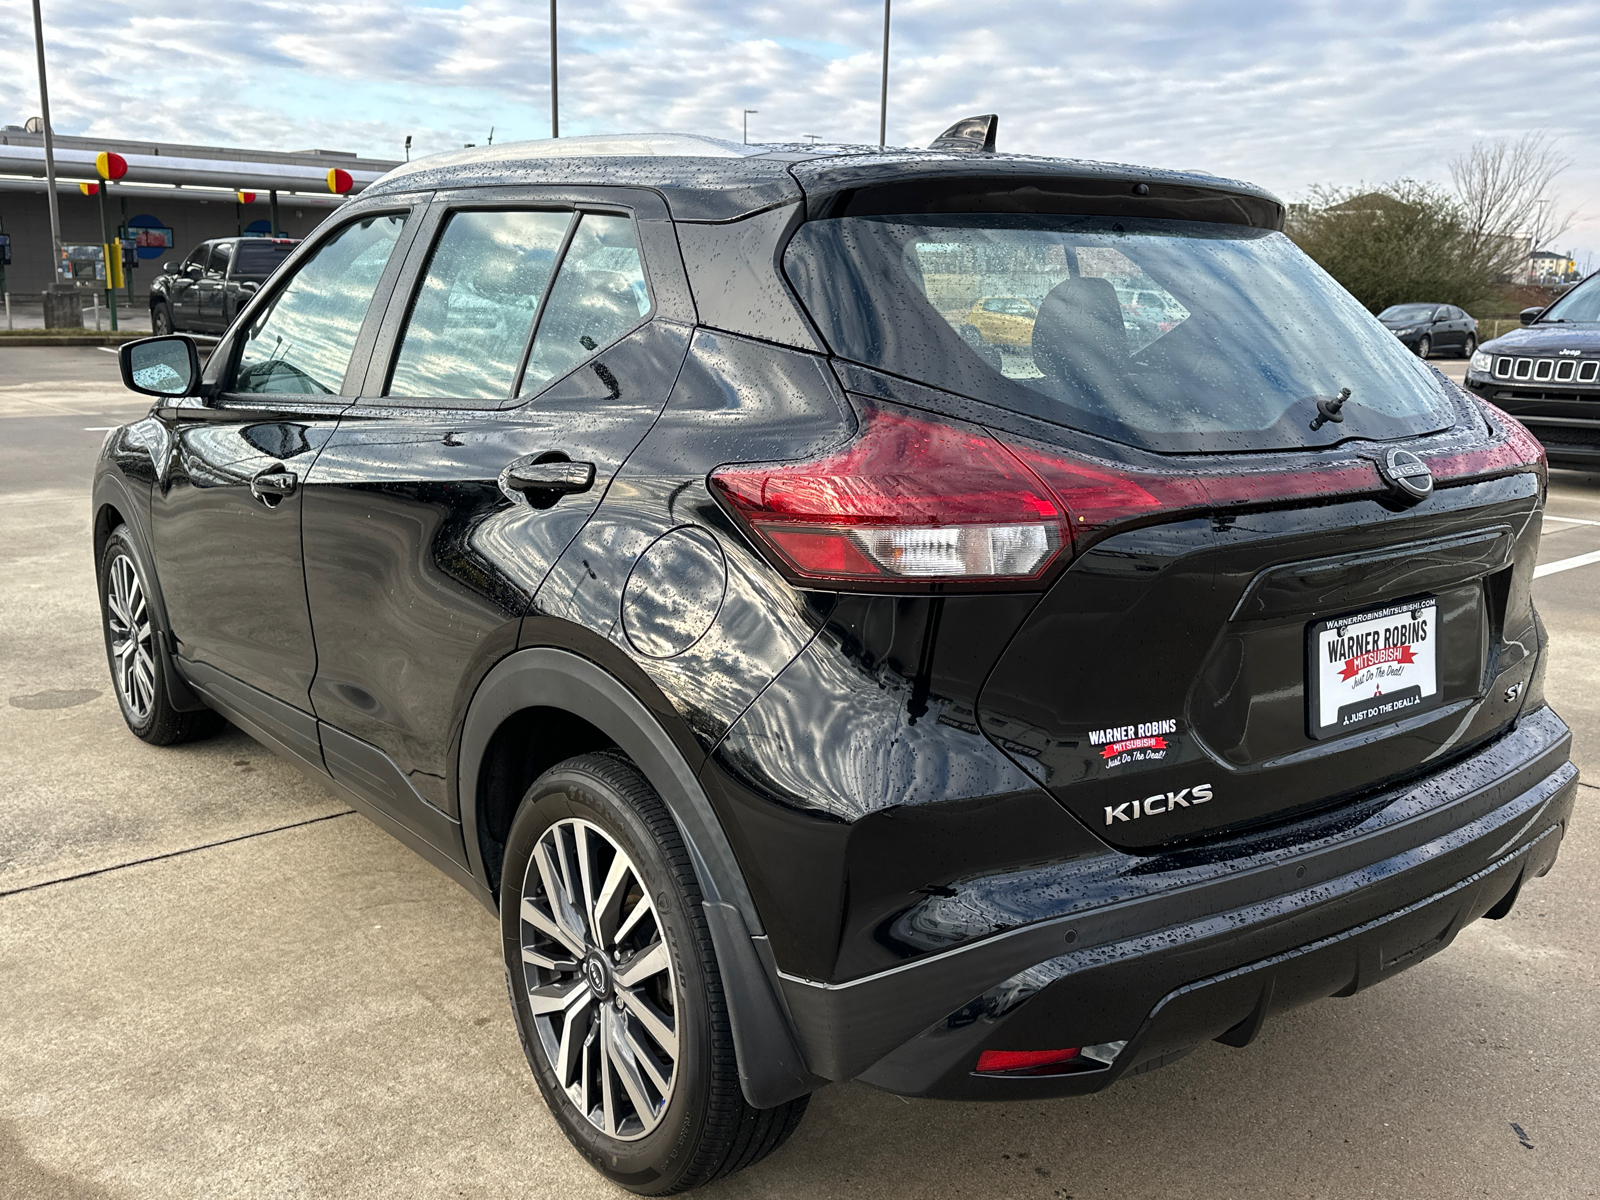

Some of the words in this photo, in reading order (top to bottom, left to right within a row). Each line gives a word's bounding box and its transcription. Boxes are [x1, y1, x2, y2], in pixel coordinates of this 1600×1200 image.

[1559, 348, 1581, 356] Jeep
[1327, 630, 1380, 663] WARNER
[1384, 619, 1428, 650] ROBINS
[1353, 647, 1403, 671] MITSUBISHI
[1351, 673, 1366, 690] Just
[1365, 669, 1375, 682] Do
[1375, 666, 1386, 678] The
[1504, 680, 1524, 703] SV
[1349, 710, 1368, 723] JUST
[1368, 707, 1379, 717] DO
[1378, 702, 1393, 714] THE
[1393, 696, 1414, 710] DEAL!
[1088, 725, 1134, 746] WARNER
[1137, 718, 1177, 739] ROBINS
[1113, 738, 1156, 753] MITSUBISHI
[1105, 758, 1122, 769] Just
[1121, 754, 1132, 764] Do
[1132, 751, 1145, 761] The
[1145, 750, 1166, 760] Deal!
[1103, 783, 1214, 826] KICKS
